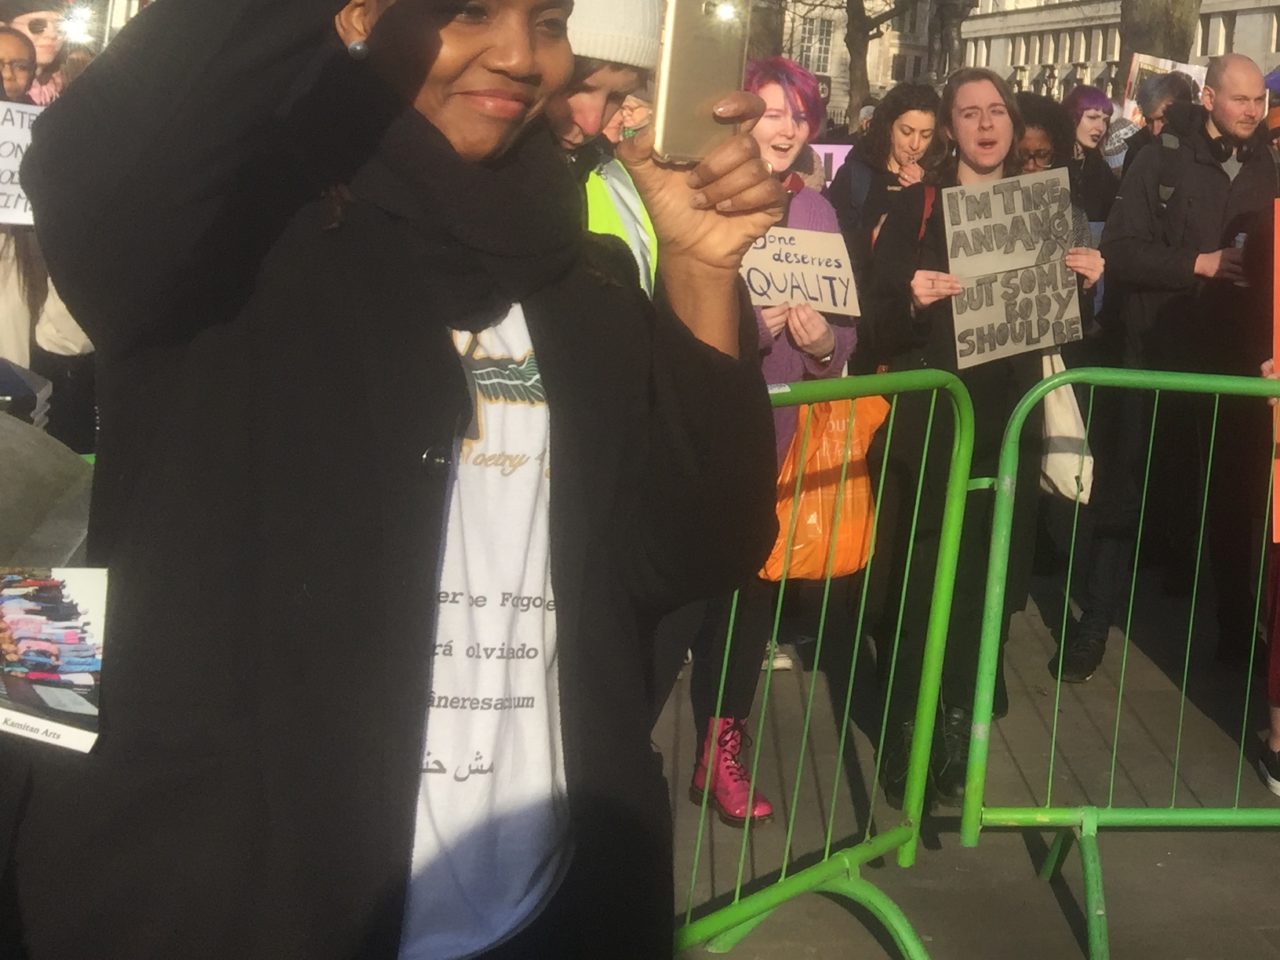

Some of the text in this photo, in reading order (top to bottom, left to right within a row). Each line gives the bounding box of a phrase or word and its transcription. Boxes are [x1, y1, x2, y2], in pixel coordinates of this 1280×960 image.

[947, 178, 1071, 226] I'M TIRED
[772, 249, 842, 269] deserves
[747, 267, 850, 307] QUALITY
[955, 260, 1076, 315] BUT SOME
[1005, 289, 1076, 324] BODY
[958, 316, 1080, 358] SHOULD BE
[2, 717, 62, 740] Kamitan Arts
